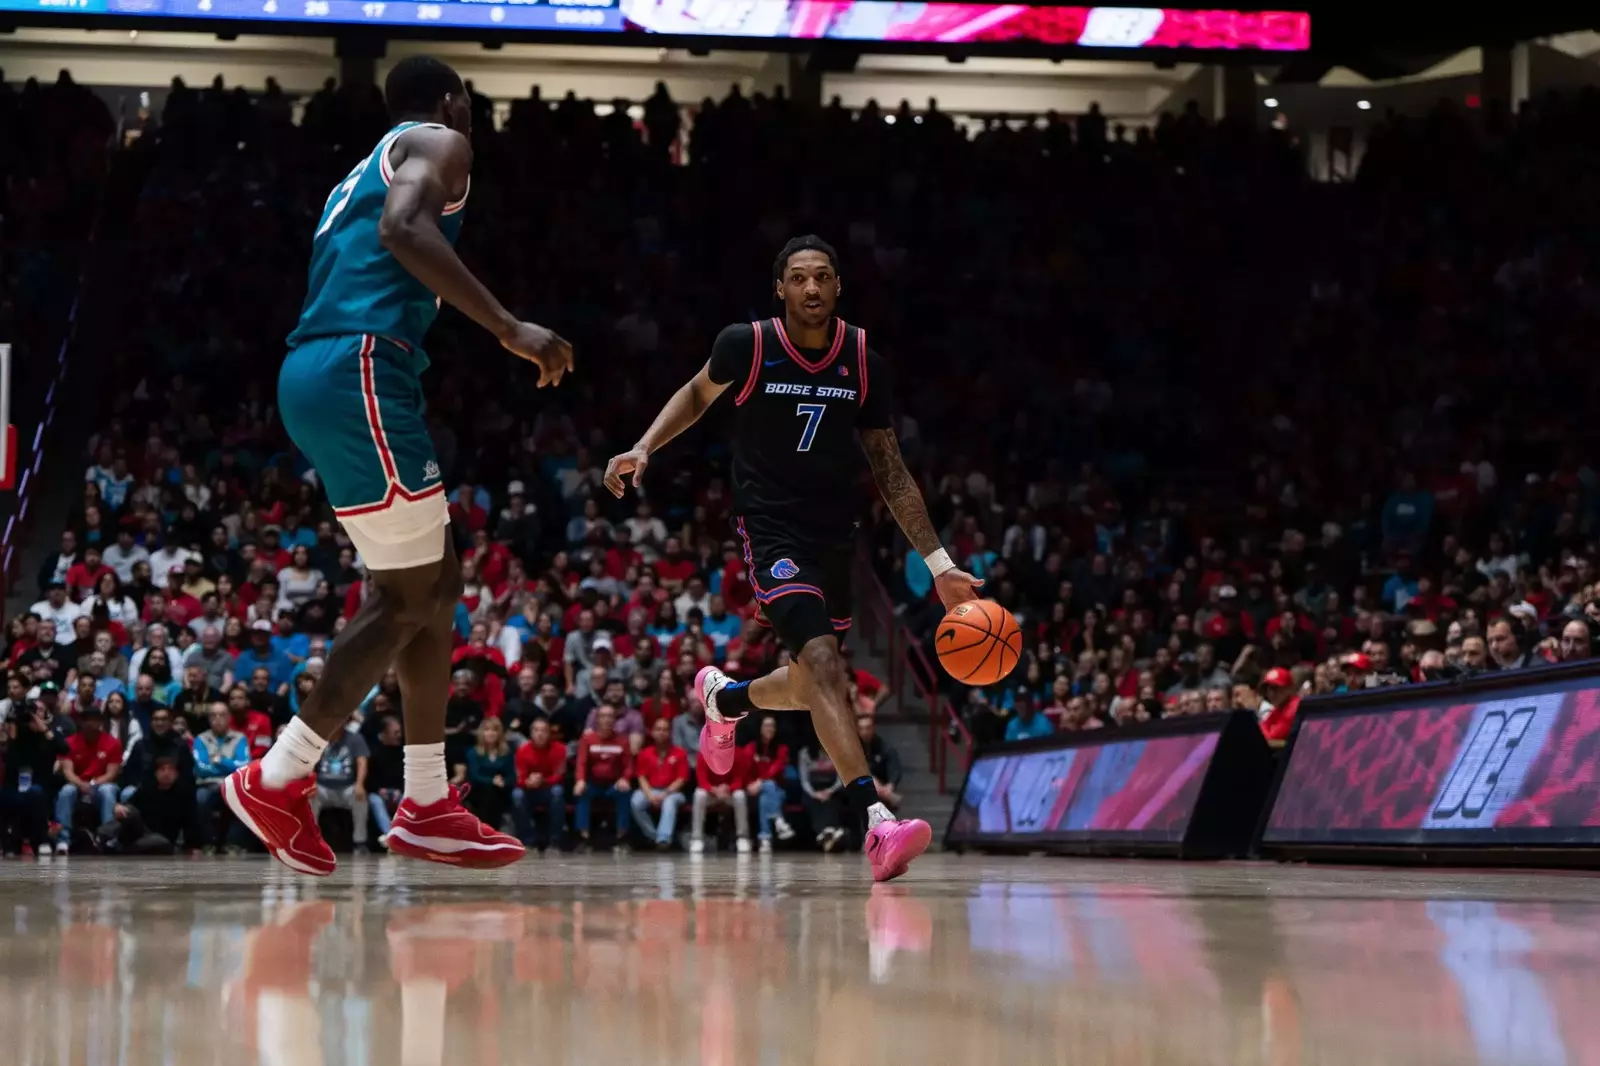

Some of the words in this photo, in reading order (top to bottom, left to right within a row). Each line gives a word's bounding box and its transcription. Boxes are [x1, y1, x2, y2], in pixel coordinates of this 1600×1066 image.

[765, 383, 812, 395] BOISE
[816, 387, 856, 400] STATE
[796, 403, 827, 451] 7
